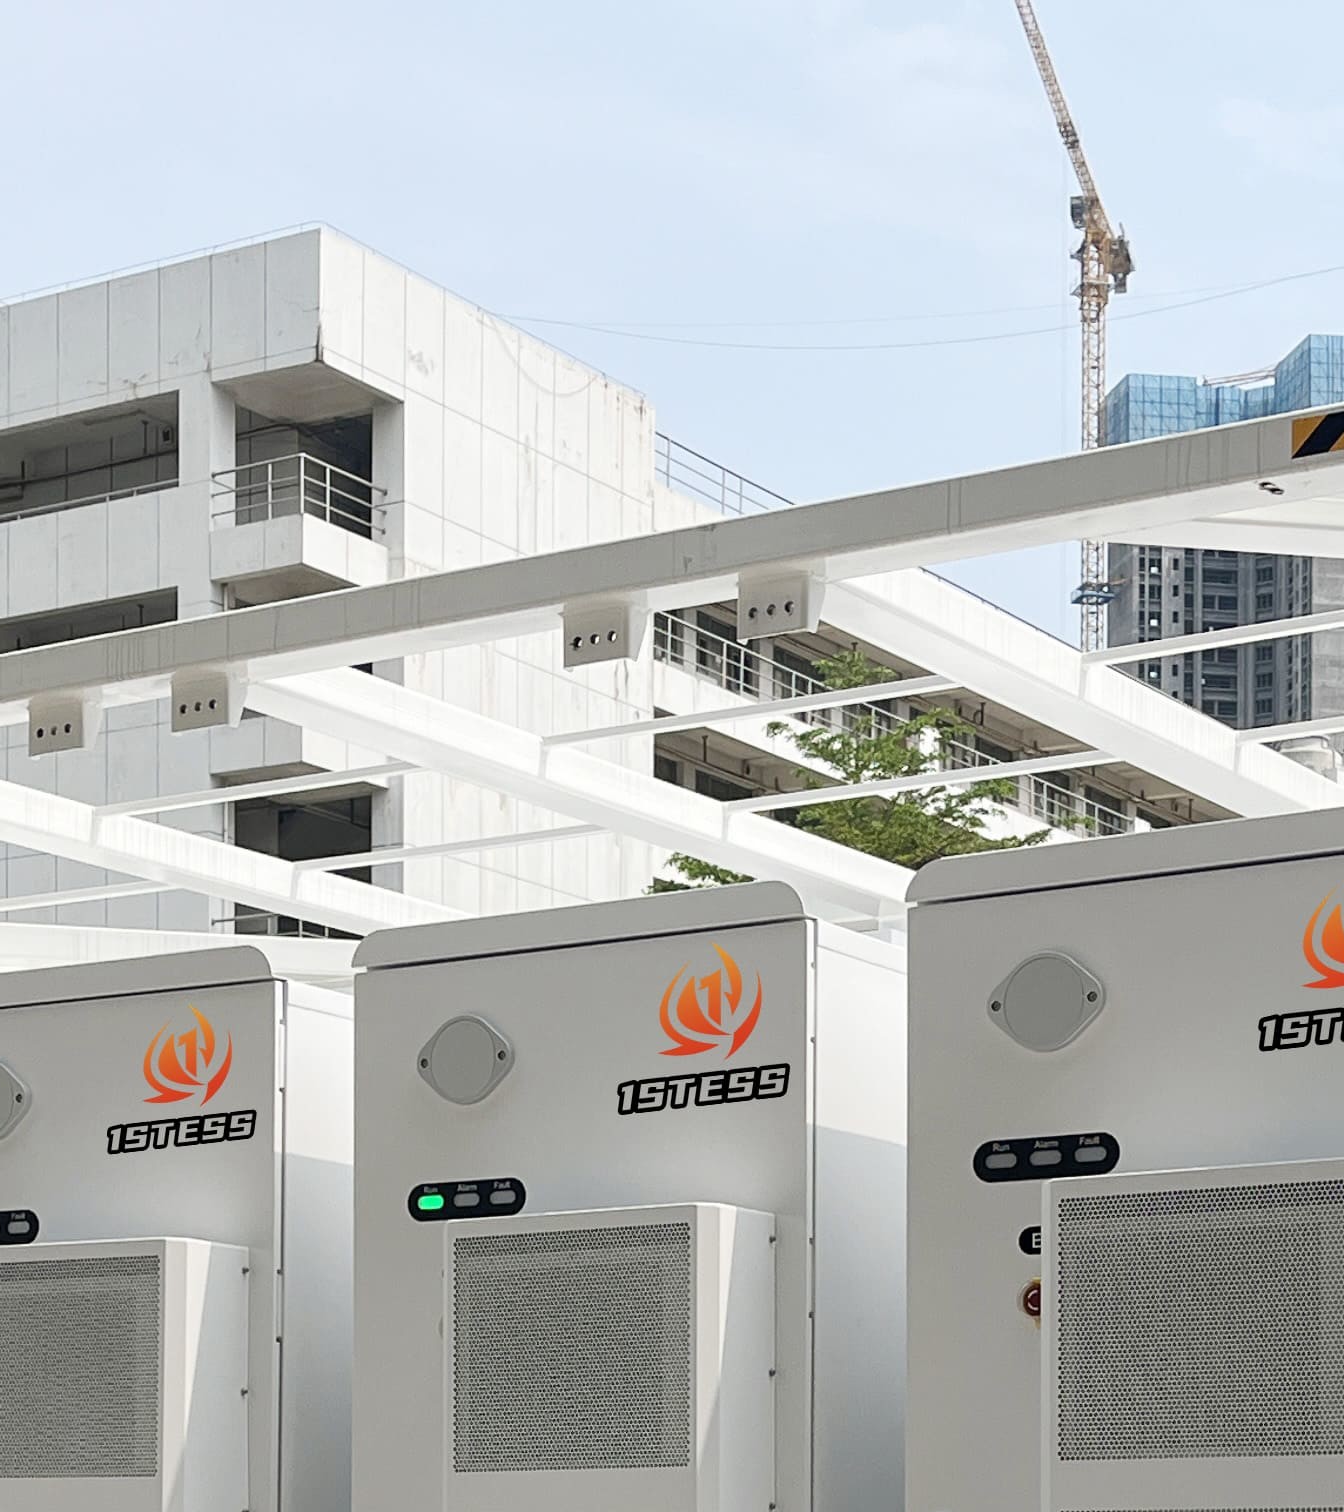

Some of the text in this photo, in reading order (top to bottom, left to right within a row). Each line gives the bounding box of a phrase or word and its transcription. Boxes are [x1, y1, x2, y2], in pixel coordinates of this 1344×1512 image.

[617, 1063, 791, 1116] 1STESS
[107, 1109, 257, 1155] 1STESS
[992, 1142, 1010, 1152] Run
